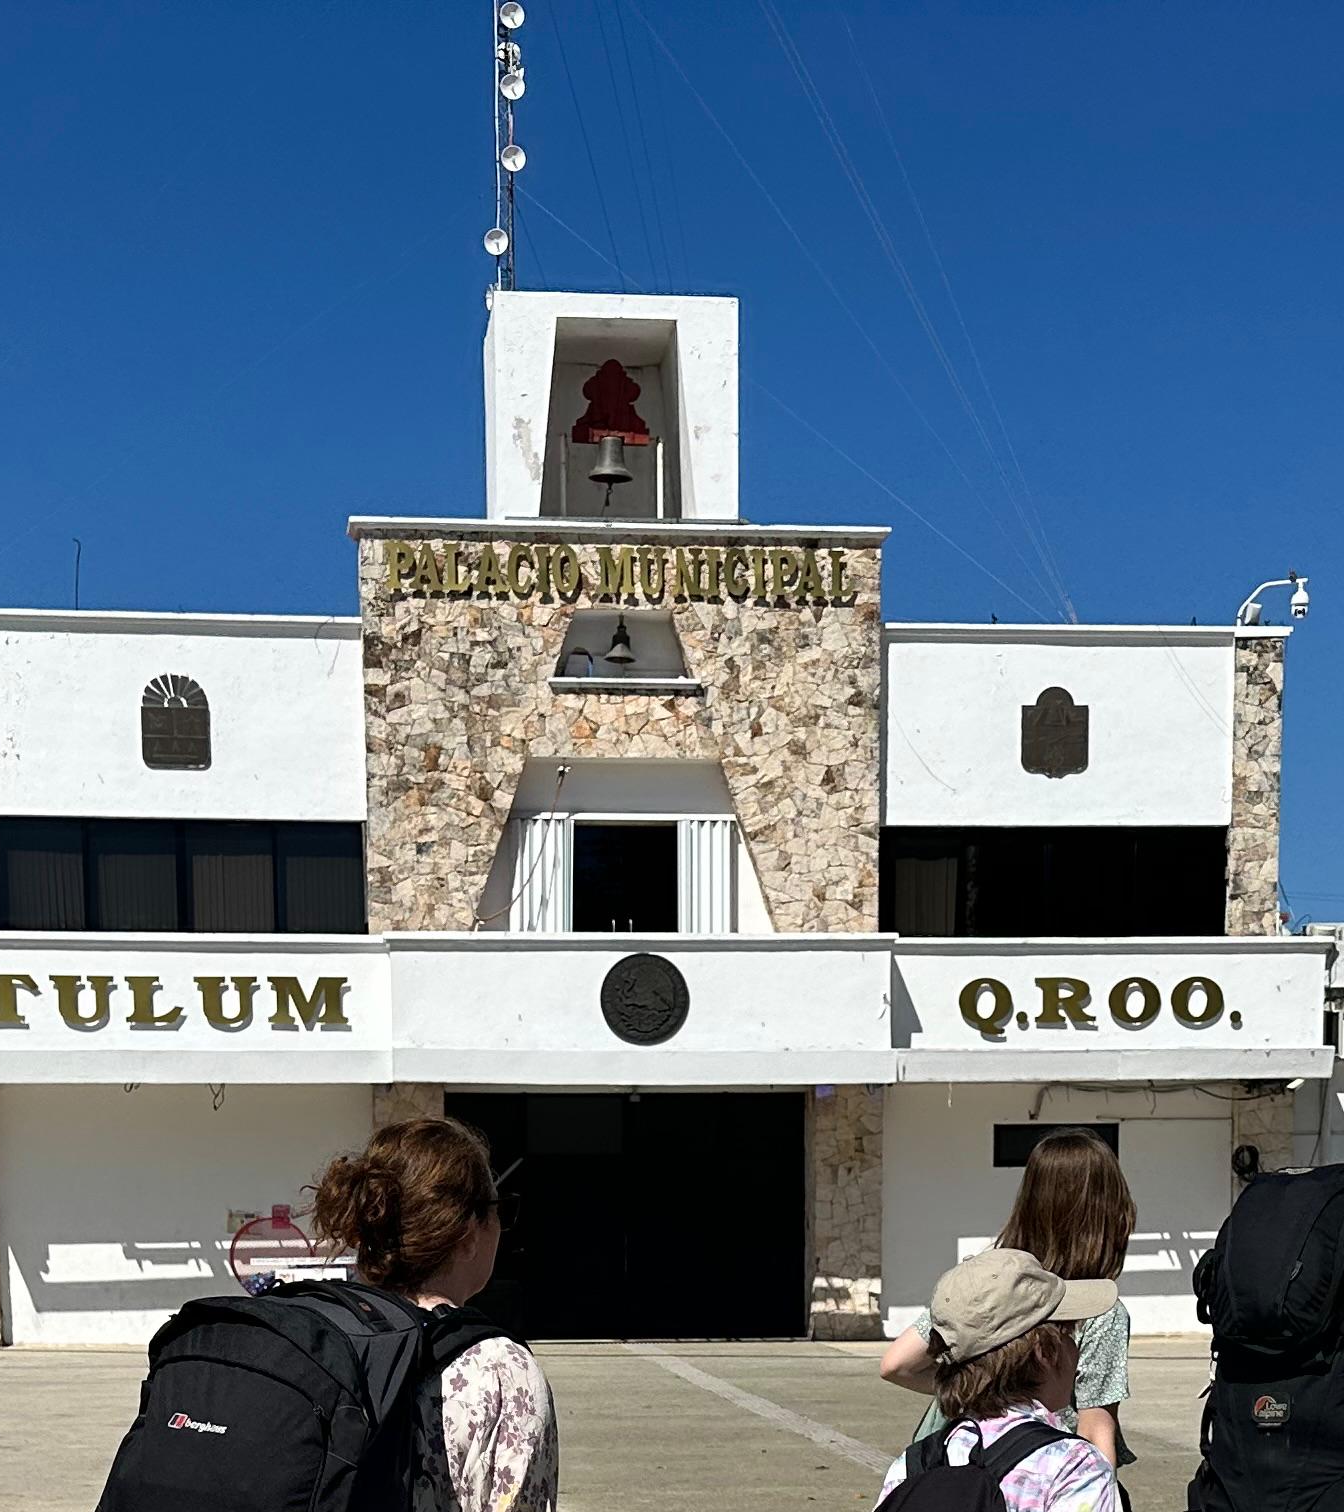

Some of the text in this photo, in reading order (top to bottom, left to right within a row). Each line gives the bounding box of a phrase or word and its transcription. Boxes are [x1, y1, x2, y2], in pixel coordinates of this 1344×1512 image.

[384, 541, 857, 598] PALACIO MUNICIPAL
[958, 975, 1242, 1035] Q.ROO.
[1265, 1402, 1288, 1411] Lowe
[1256, 1410, 1284, 1420] alpine
[185, 1418, 227, 1434] berghaus
